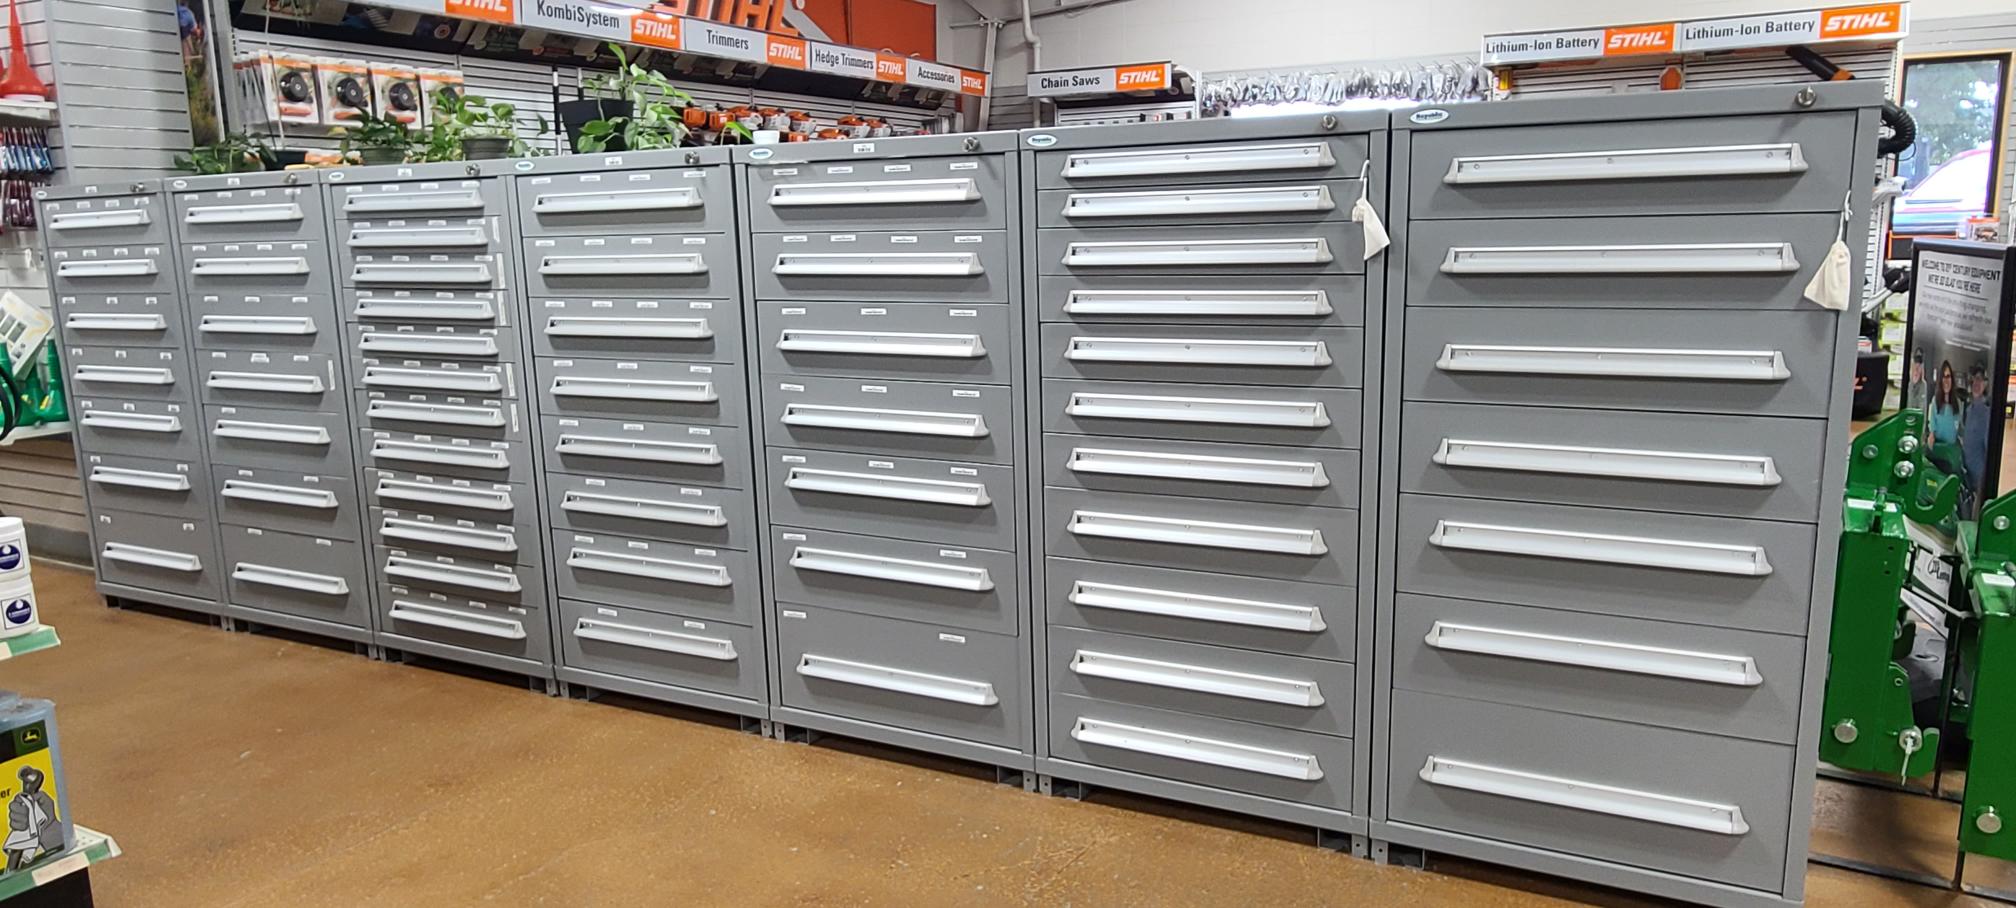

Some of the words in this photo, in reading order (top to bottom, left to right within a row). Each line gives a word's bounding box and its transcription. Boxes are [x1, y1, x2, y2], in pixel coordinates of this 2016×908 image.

[448, 0, 507, 12] IHL
[537, 0, 620, 28] KombiSystem
[634, 19, 676, 39] STIHL
[1685, 24, 1761, 41] Lithium-Ion
[1765, 19, 1816, 34] Battery
[1824, 12, 1890, 32] STIHL
[706, 29, 749, 50] Trimmers
[769, 43, 802, 61] STIHL
[1486, 39, 1552, 54] Lithium-Ion
[1556, 37, 1600, 49] Battery
[1607, 31, 1666, 48] STIHL
[815, 48, 839, 67] Hedge
[841, 53, 874, 70] Trimmers
[877, 60, 904, 76] STIHL
[917, 66, 955, 84] Accessories
[962, 77, 983, 90] STIHL
[1041, 77, 1069, 89] Chain
[1072, 75, 1100, 87] Saws
[1118, 70, 1160, 84] STIHL
